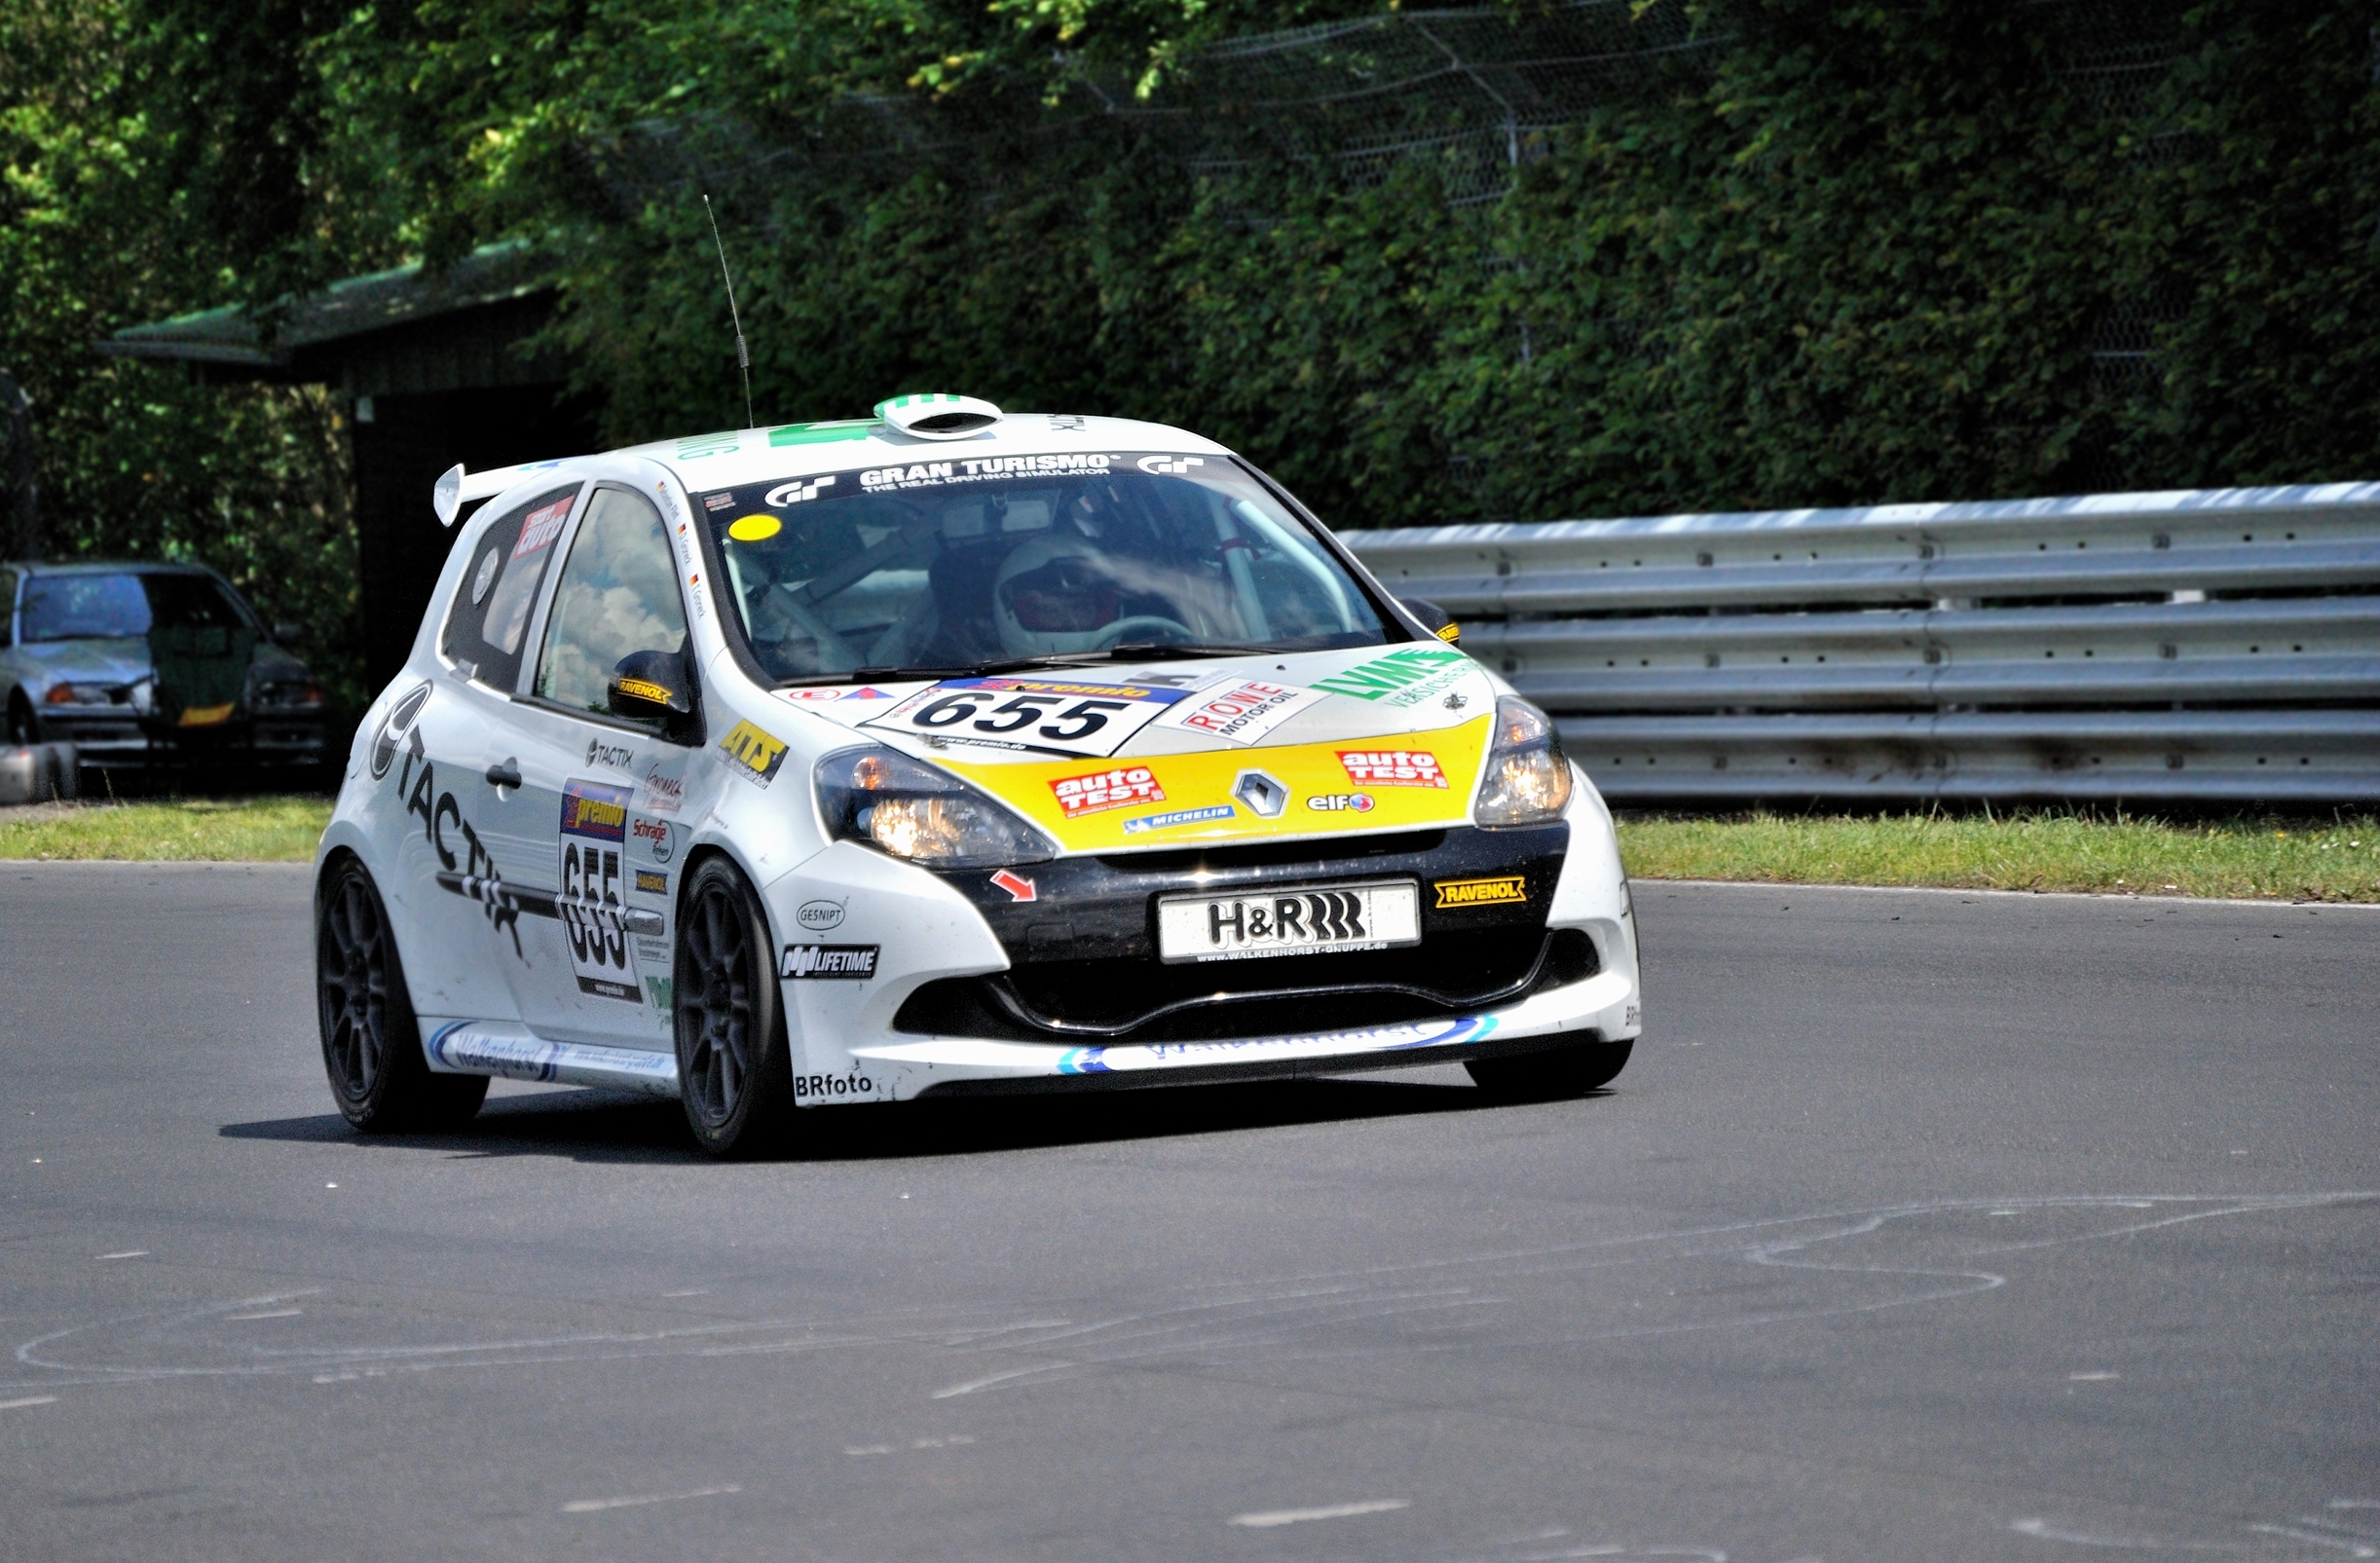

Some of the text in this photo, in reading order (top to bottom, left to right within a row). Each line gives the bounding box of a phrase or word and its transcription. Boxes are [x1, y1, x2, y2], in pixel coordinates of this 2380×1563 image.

[859, 454, 1110, 487] GRAN TURISMO
[862, 467, 1111, 494] THE REAL DRIVING SIMULATOR
[619, 681, 662, 699] RAVENOL
[912, 692, 1133, 741] 655
[1187, 684, 1284, 731] ROWE
[1219, 690, 1298, 736] MOTOR OIL
[597, 745, 634, 768] TACTIX
[719, 719, 786, 772] ATS
[1343, 751, 1435, 767] auto
[1056, 768, 1152, 797] auto
[1348, 765, 1439, 780] TEST
[1060, 781, 1156, 810] TEST
[1307, 795, 1350, 810] elf
[575, 795, 625, 829] premio
[1152, 807, 1229, 826] MICHELIN
[633, 819, 666, 844] Schrage
[1445, 881, 1518, 903] RAVENOL
[562, 842, 625, 970] 655
[800, 909, 842, 922] GESNIPT
[814, 951, 875, 972] LIFETIME
[795, 1073, 873, 1098] BRfoto
